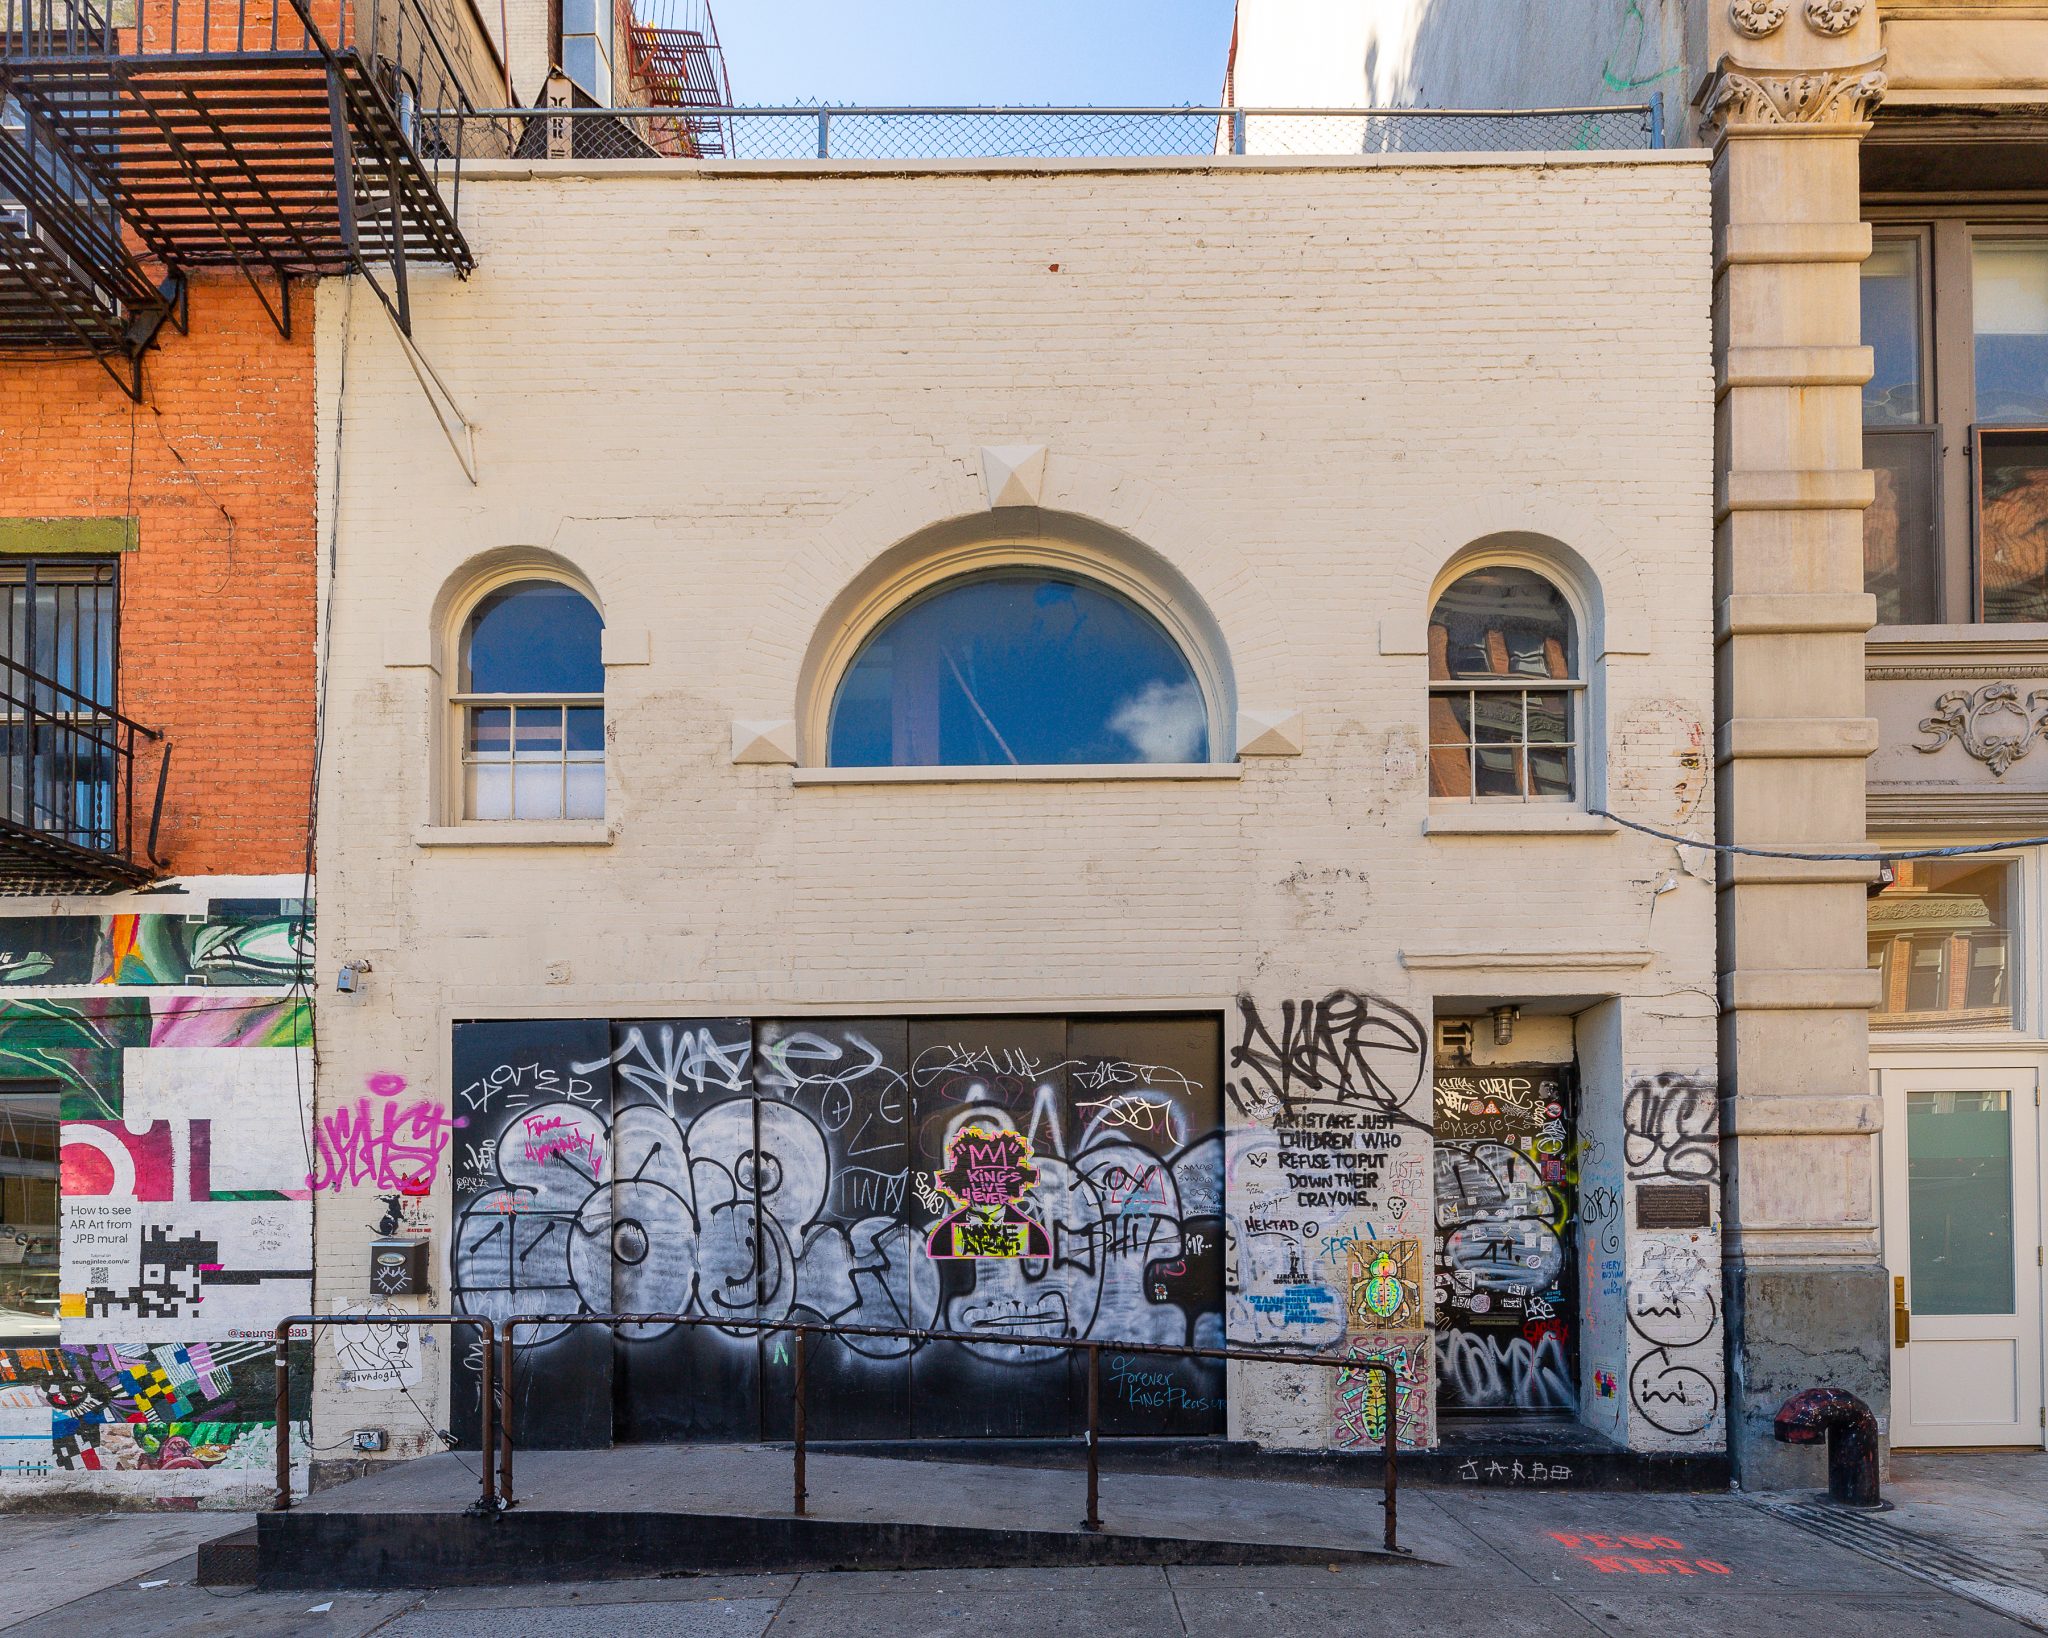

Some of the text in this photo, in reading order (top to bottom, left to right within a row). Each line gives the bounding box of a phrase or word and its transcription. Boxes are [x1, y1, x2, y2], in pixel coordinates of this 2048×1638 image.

[1361, 1132, 1402, 1150] WHO
[1278, 1152, 1335, 1169] REFUSE
[1286, 1168, 1379, 1189] DOWN THEIR
[71, 1205, 132, 1215] How to see
[70, 1219, 132, 1230] AR Art from
[72, 1233, 129, 1244] JPB mural
[1549, 1531, 1685, 1551] PESO
[1582, 1555, 1731, 1575] NETO
